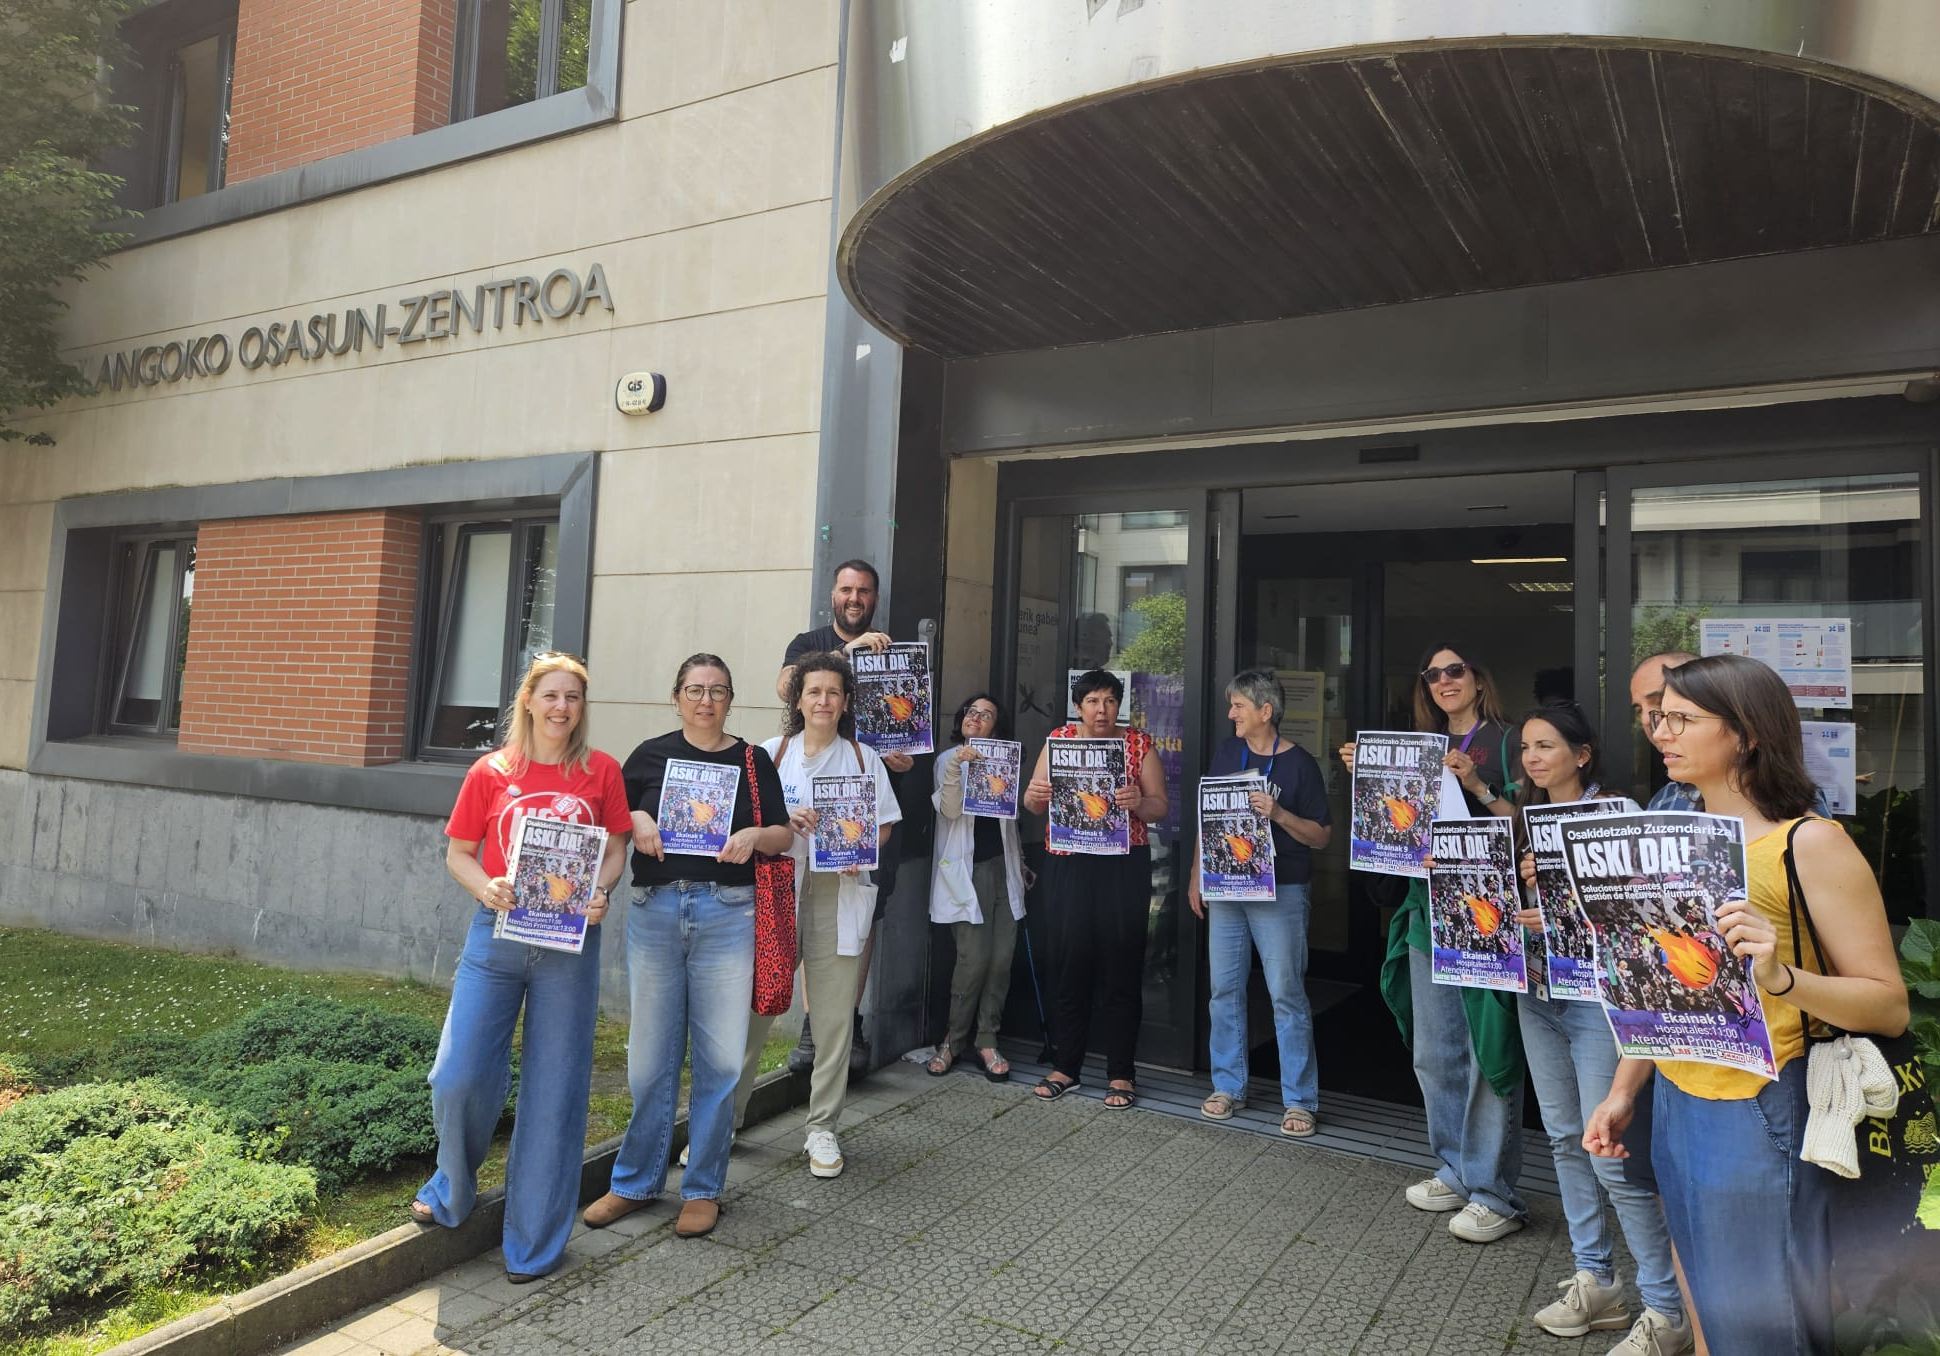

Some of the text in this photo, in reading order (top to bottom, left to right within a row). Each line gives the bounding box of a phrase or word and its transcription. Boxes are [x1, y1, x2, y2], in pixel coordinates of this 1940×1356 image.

[94, 263, 614, 391] ANGOKO OSASUN-ZENTROA
[857, 654, 910, 672] ASKI DA!
[1052, 749, 1108, 768] ASKI DA!
[1358, 745, 1420, 768] ASKI DA!
[669, 766, 722, 784] ASKI DA!
[814, 783, 860, 799] ASKI DA!
[1202, 792, 1250, 810] ASKI DA!
[1432, 826, 1466, 834] Osakidetzako
[1532, 824, 1562, 852] ASK
[1567, 826, 1642, 841] Osakidetzako
[524, 826, 557, 849] ASKI
[558, 831, 584, 853] DA!
[1376, 842, 1402, 852] Ekainak
[1432, 834, 1491, 859] ASKI DA!
[1572, 836, 1692, 879] ASKI DA!
[1581, 884, 1622, 893] Soluciones
[1624, 882, 1661, 894] urgentes
[1663, 882, 1685, 892] para
[1584, 892, 1613, 902] gestión
[1613, 892, 1624, 900] de
[1625, 890, 1662, 900] Recursos
[528, 910, 554, 918] Ekainak
[508, 918, 532, 928] Atención
[1462, 951, 1497, 962] Ekainak 9
[1577, 959, 1594, 969] Ekai
[1440, 966, 1470, 975] Atención
[1558, 976, 1588, 987] Atención
[1662, 1012, 1726, 1026] Ekainak 9
[1656, 1024, 1738, 1040] Hospitales:11:00
[1631, 1034, 1764, 1060] Atención Primaria:13:00
